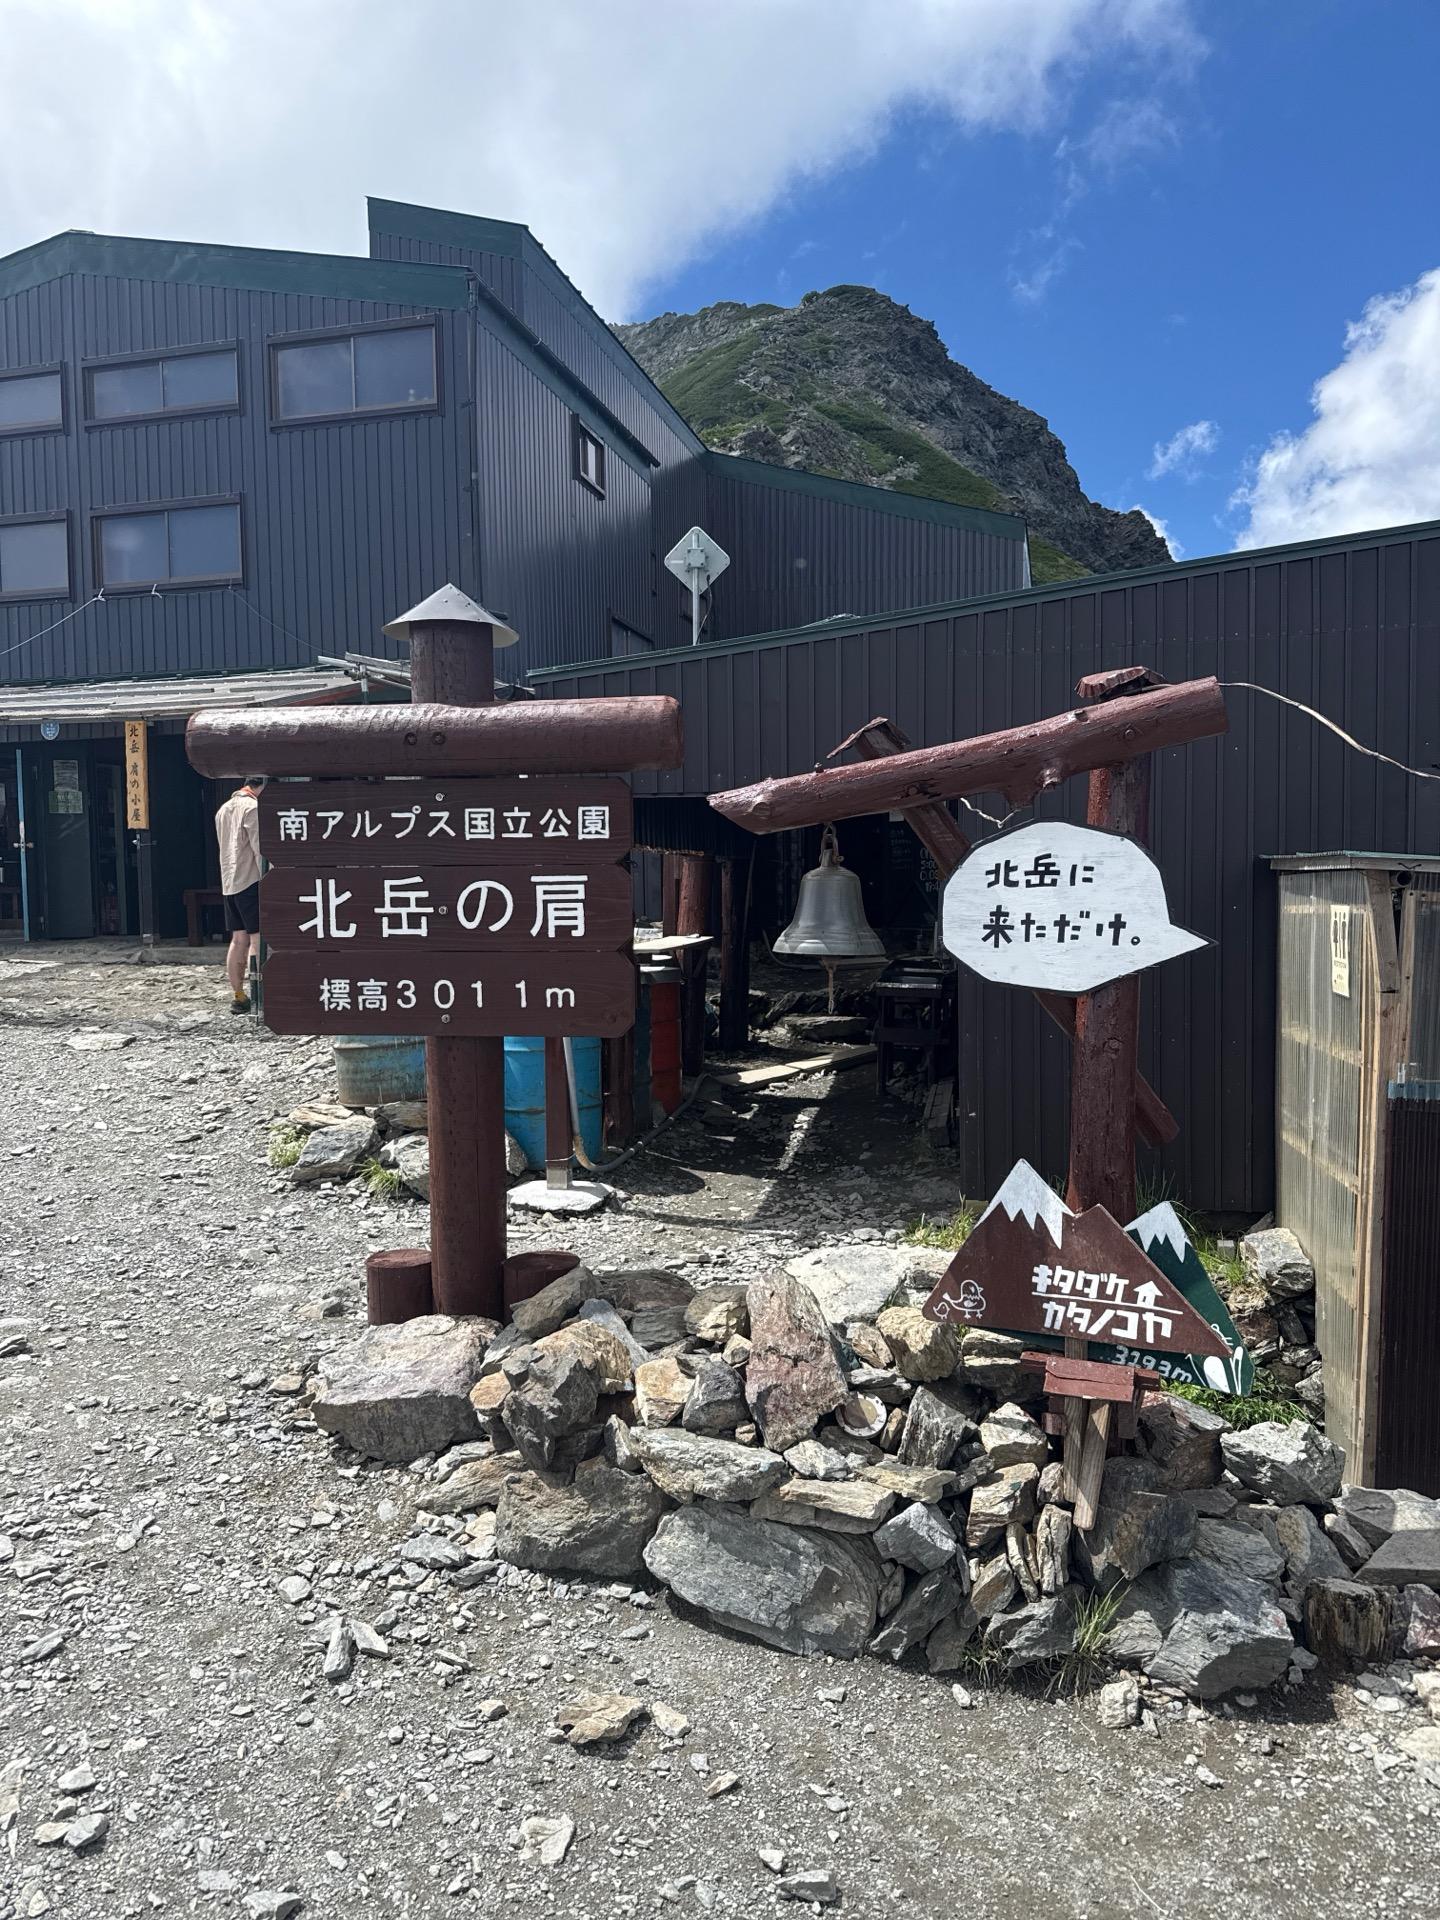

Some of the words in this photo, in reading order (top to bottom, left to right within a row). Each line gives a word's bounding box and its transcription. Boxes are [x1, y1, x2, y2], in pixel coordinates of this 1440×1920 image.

[277, 805, 611, 841] 南アルプス国立公園
[985, 853, 1095, 889] 北岳に
[298, 875, 588, 939] 北岳の肩
[981, 905, 1141, 948] 来ただけ。
[319, 977, 576, 1012] 標高3011m
[1031, 1264, 1130, 1302] キタダケ
[1042, 1301, 1173, 1344] カタノコヤ
